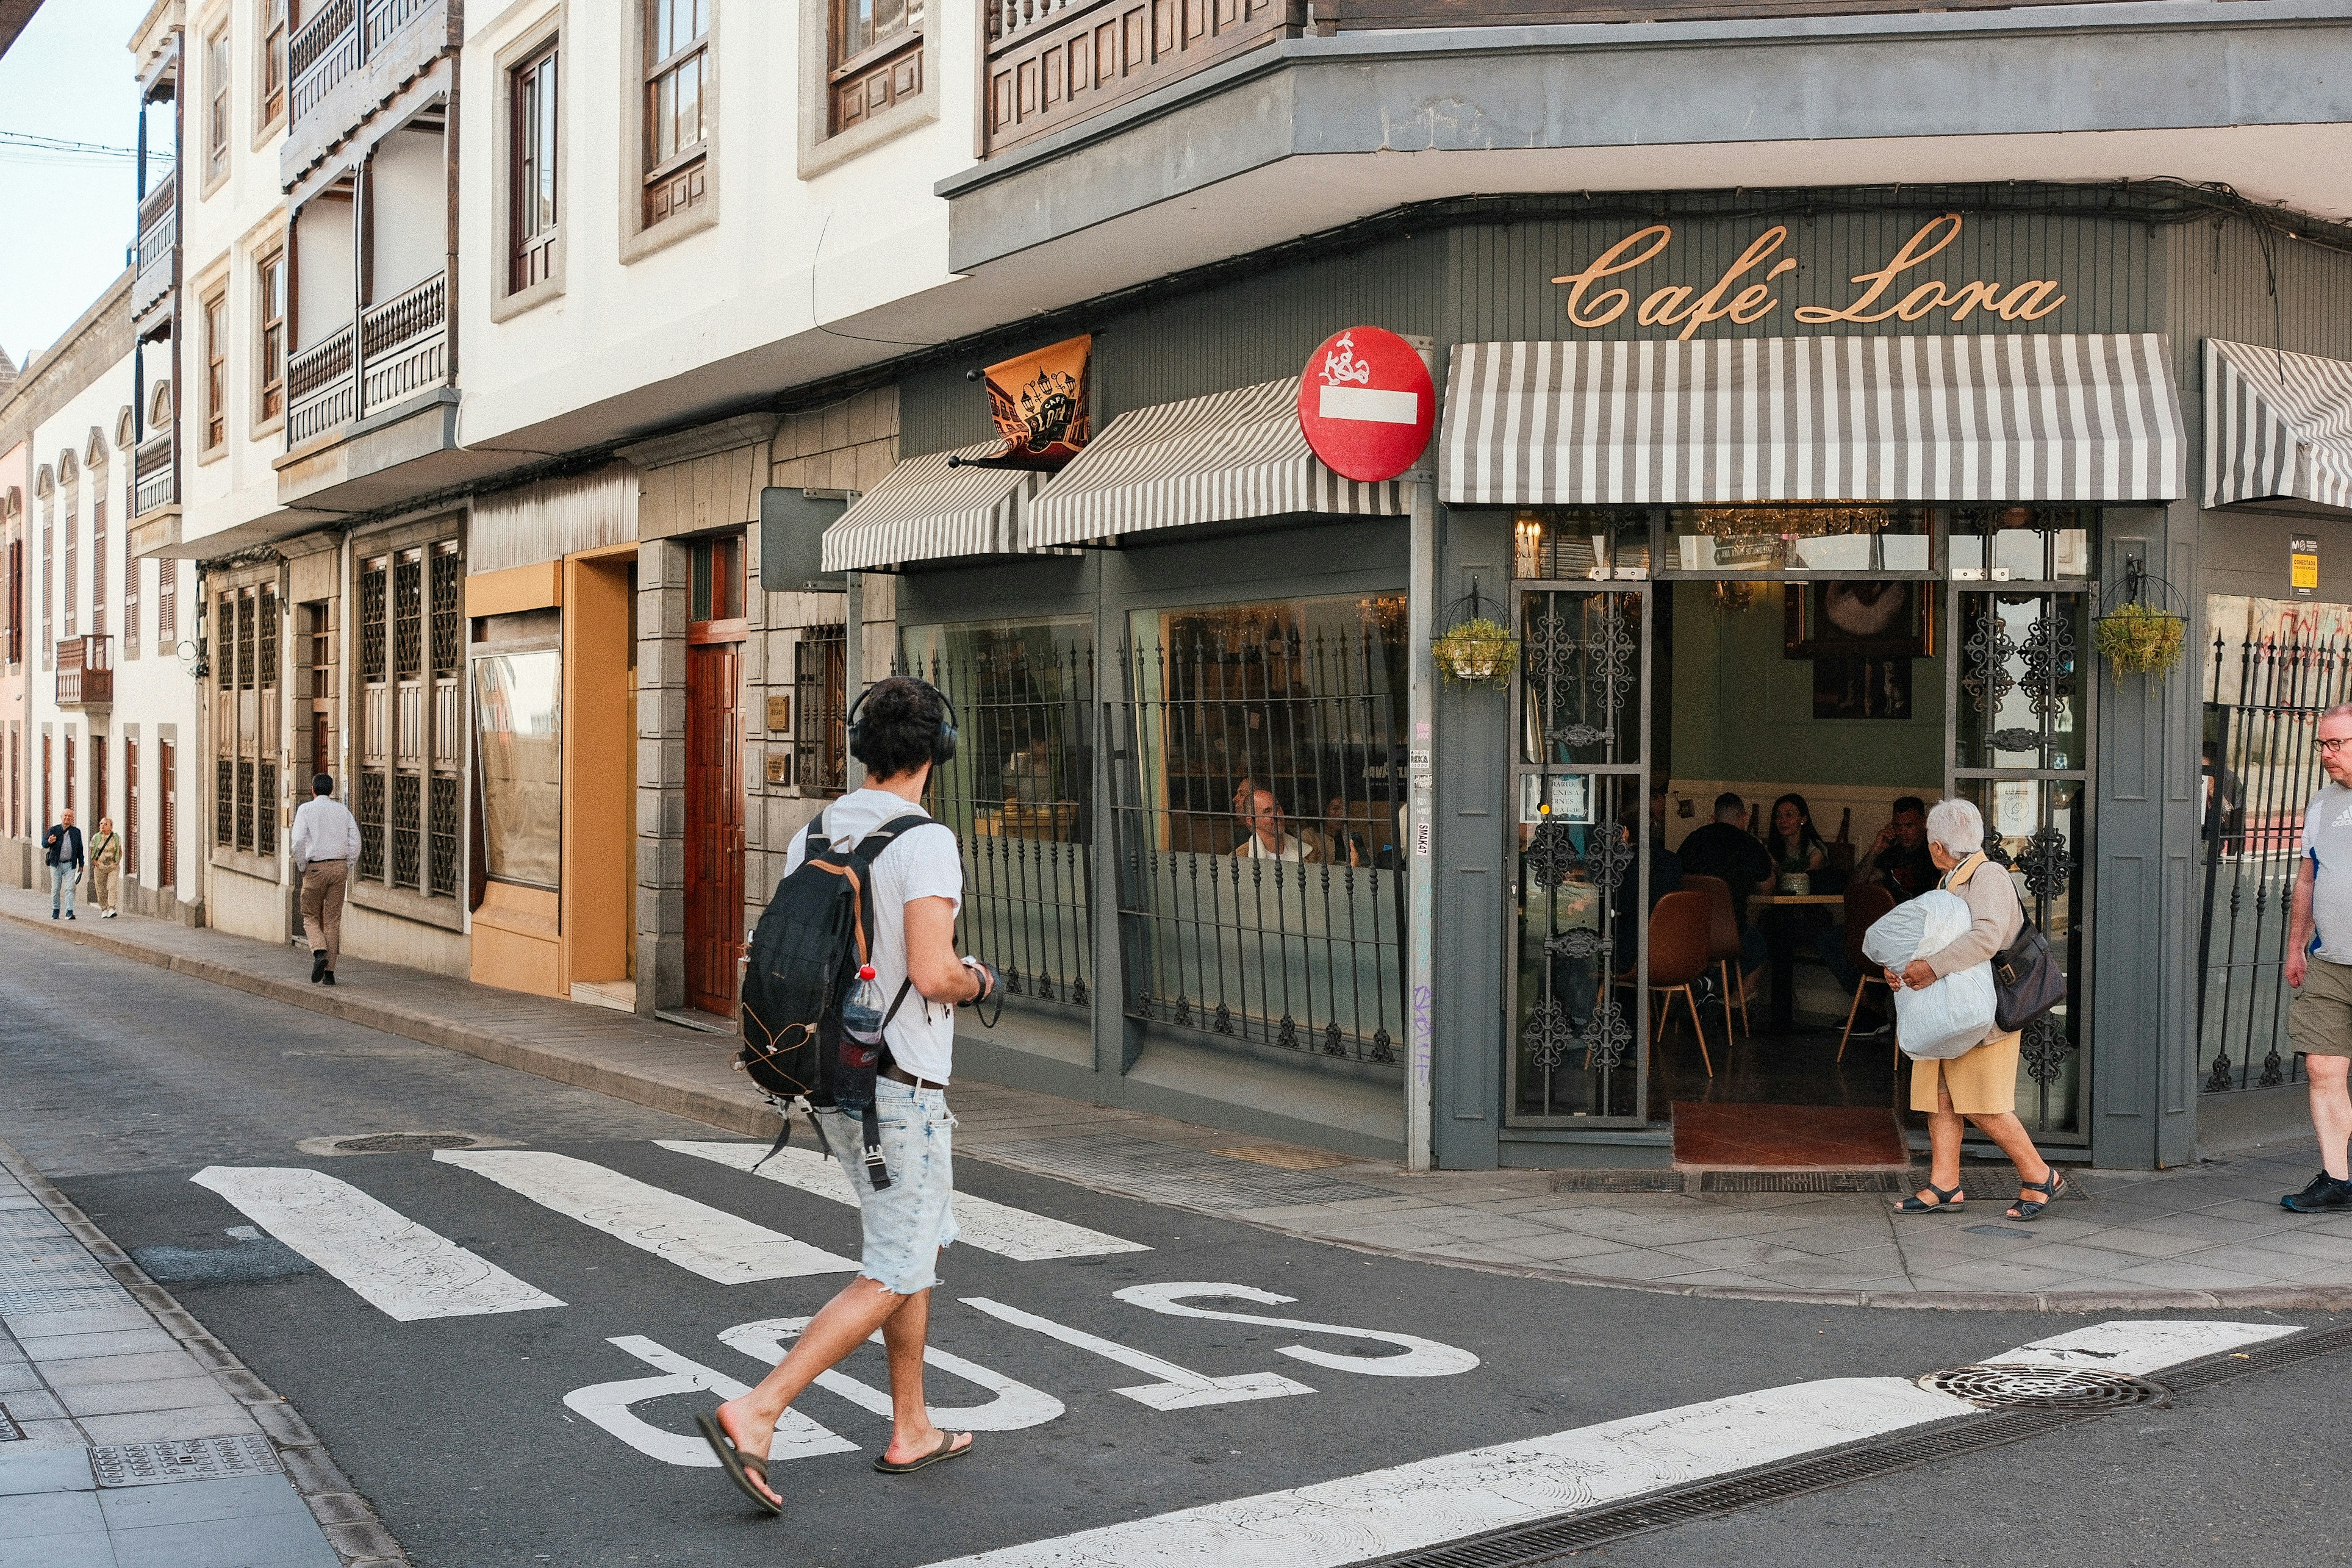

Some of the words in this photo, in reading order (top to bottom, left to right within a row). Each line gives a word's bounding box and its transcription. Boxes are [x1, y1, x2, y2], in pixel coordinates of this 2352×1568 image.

[1551, 224, 1796, 340] Café
[1794, 213, 2067, 323] Lora
[1418, 825, 1428, 854] SMAK47
[563, 1281, 1481, 1469] STOP
